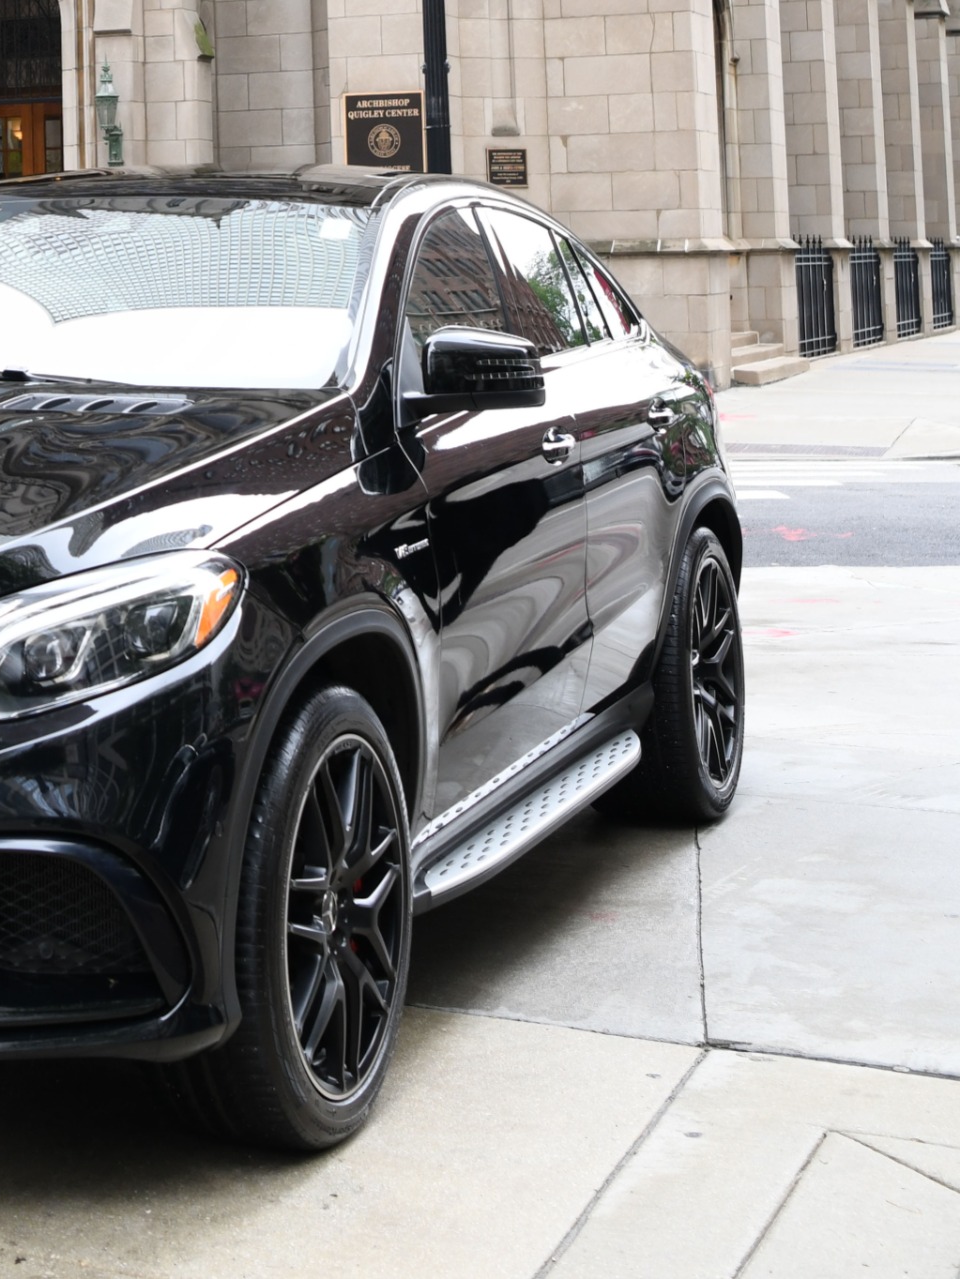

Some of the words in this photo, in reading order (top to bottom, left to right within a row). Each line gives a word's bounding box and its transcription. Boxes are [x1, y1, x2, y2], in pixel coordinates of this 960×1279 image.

[356, 99, 410, 108] ARCHBISHOP
[348, 110, 385, 120] QUIGLEY
[385, 108, 419, 117] CENTER
